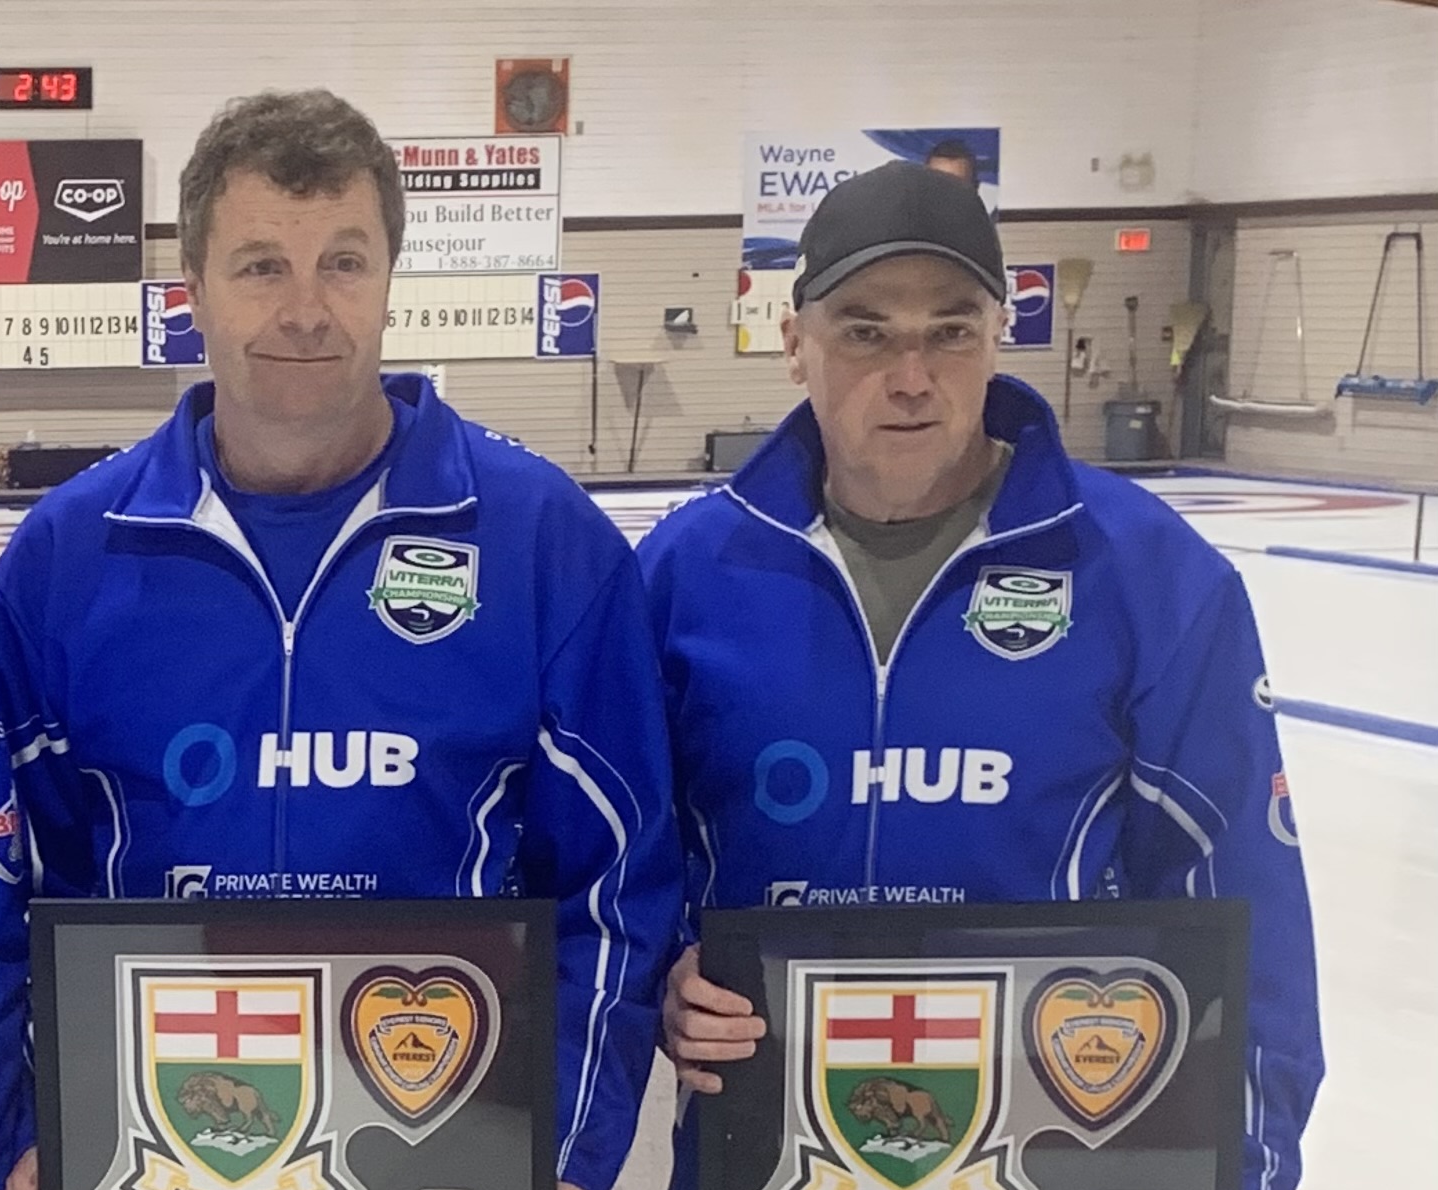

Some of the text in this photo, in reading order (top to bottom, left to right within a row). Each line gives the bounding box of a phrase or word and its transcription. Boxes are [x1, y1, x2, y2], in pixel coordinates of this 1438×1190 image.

[14, 74, 77, 100] 2:43
[465, 145, 540, 165] & Yates
[760, 146, 835, 166] Wayne
[459, 173, 535, 188] Supplies
[760, 171, 858, 197] EWAS
[62, 188, 118, 204] CO-OP
[435, 204, 484, 223] Build
[491, 203, 553, 222] Better
[757, 203, 806, 212] MLA for
[72, 235, 82, 244] at
[84, 234, 111, 244] home
[113, 234, 137, 245] here.
[438, 255, 554, 269] 1-888-387-8664
[5, 318, 13, 335] 7
[22, 318, 31, 335] 8
[40, 317, 49, 335] 9
[56, 317, 69, 335] 10
[74, 317, 85, 335] 11
[90, 317, 103, 334] 12
[108, 316, 121, 334] 13
[125, 316, 138, 333] 14
[148, 285, 166, 363] PEPSI
[386, 307, 534, 327] 6 7 8 9 10 11 12 13 14
[542, 278, 561, 354] PEPSI
[23, 346, 32, 364] 4
[40, 347, 48, 366] 5
[390, 570, 464, 587] VITERRA
[984, 597, 1058, 607] VITERRA
[258, 731, 419, 788] HUB
[851, 748, 1013, 805] HUB
[215, 873, 292, 891] PRIVATE
[297, 874, 377, 891] WEALTH
[808, 886, 965, 905] PRIVATE WEALTH
[393, 1052, 436, 1061] EVEREST
[1075, 1055, 1120, 1063] EVEREST
